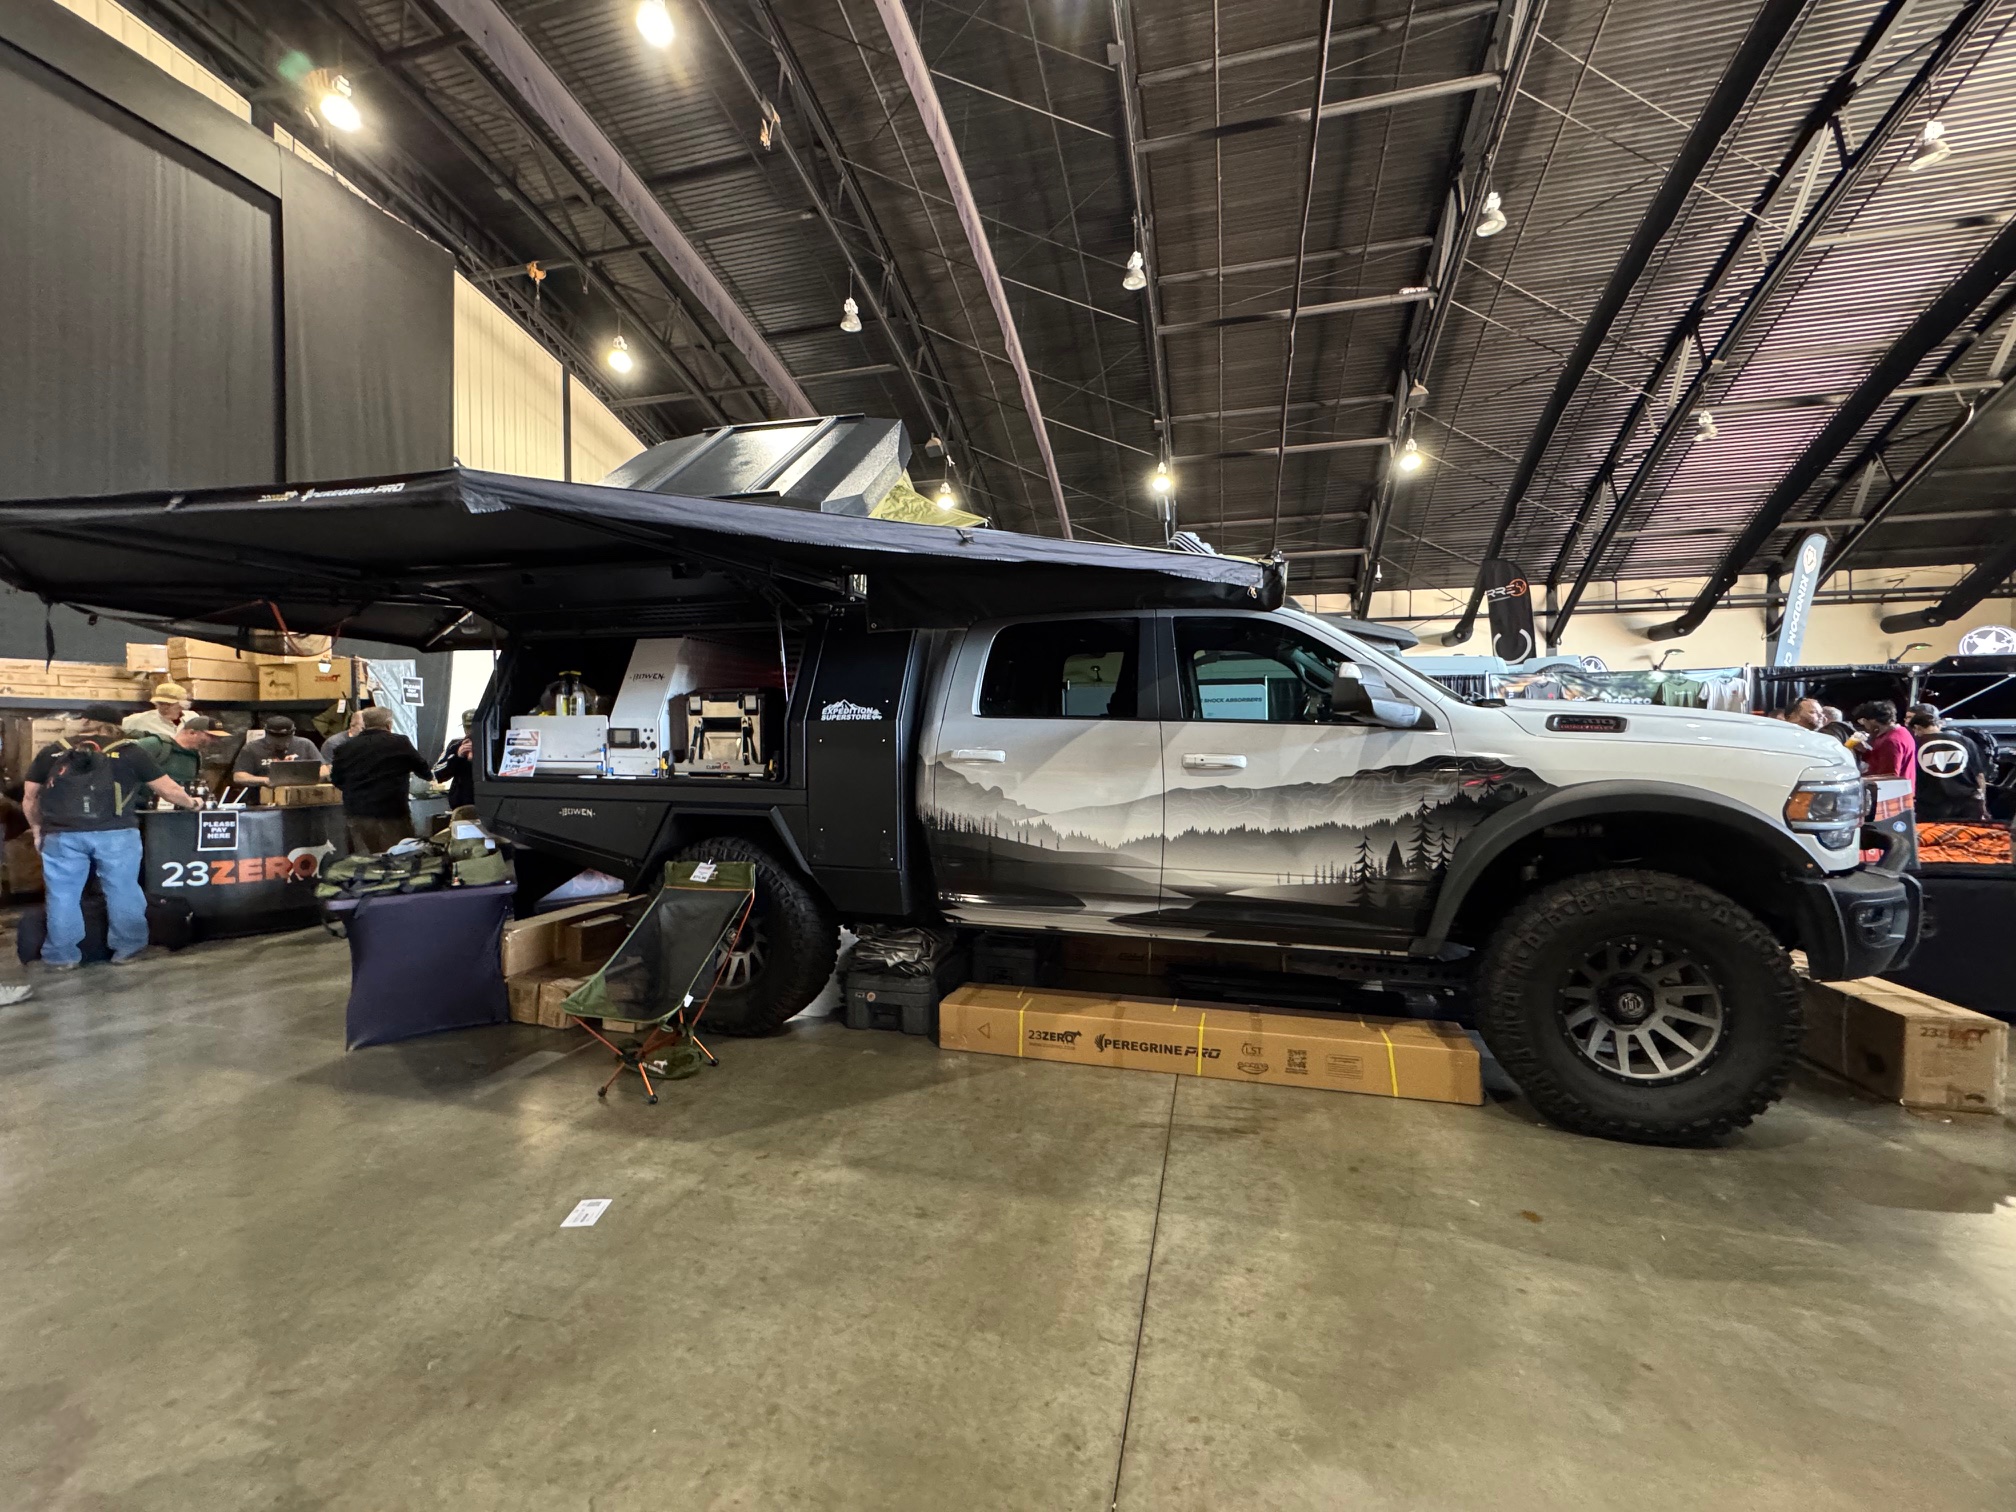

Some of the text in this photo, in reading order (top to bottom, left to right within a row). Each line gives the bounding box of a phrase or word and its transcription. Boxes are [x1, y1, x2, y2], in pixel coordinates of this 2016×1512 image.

[632, 673, 664, 681] BOWEN
[822, 706, 874, 714] EXPEDITION
[821, 713, 872, 721] SUPERSTORE
[561, 807, 593, 818] BOWEN
[161, 853, 318, 888] 23ZERO
[1028, 1030, 1221, 1059] 23ZERO PEREGRINE PRO
